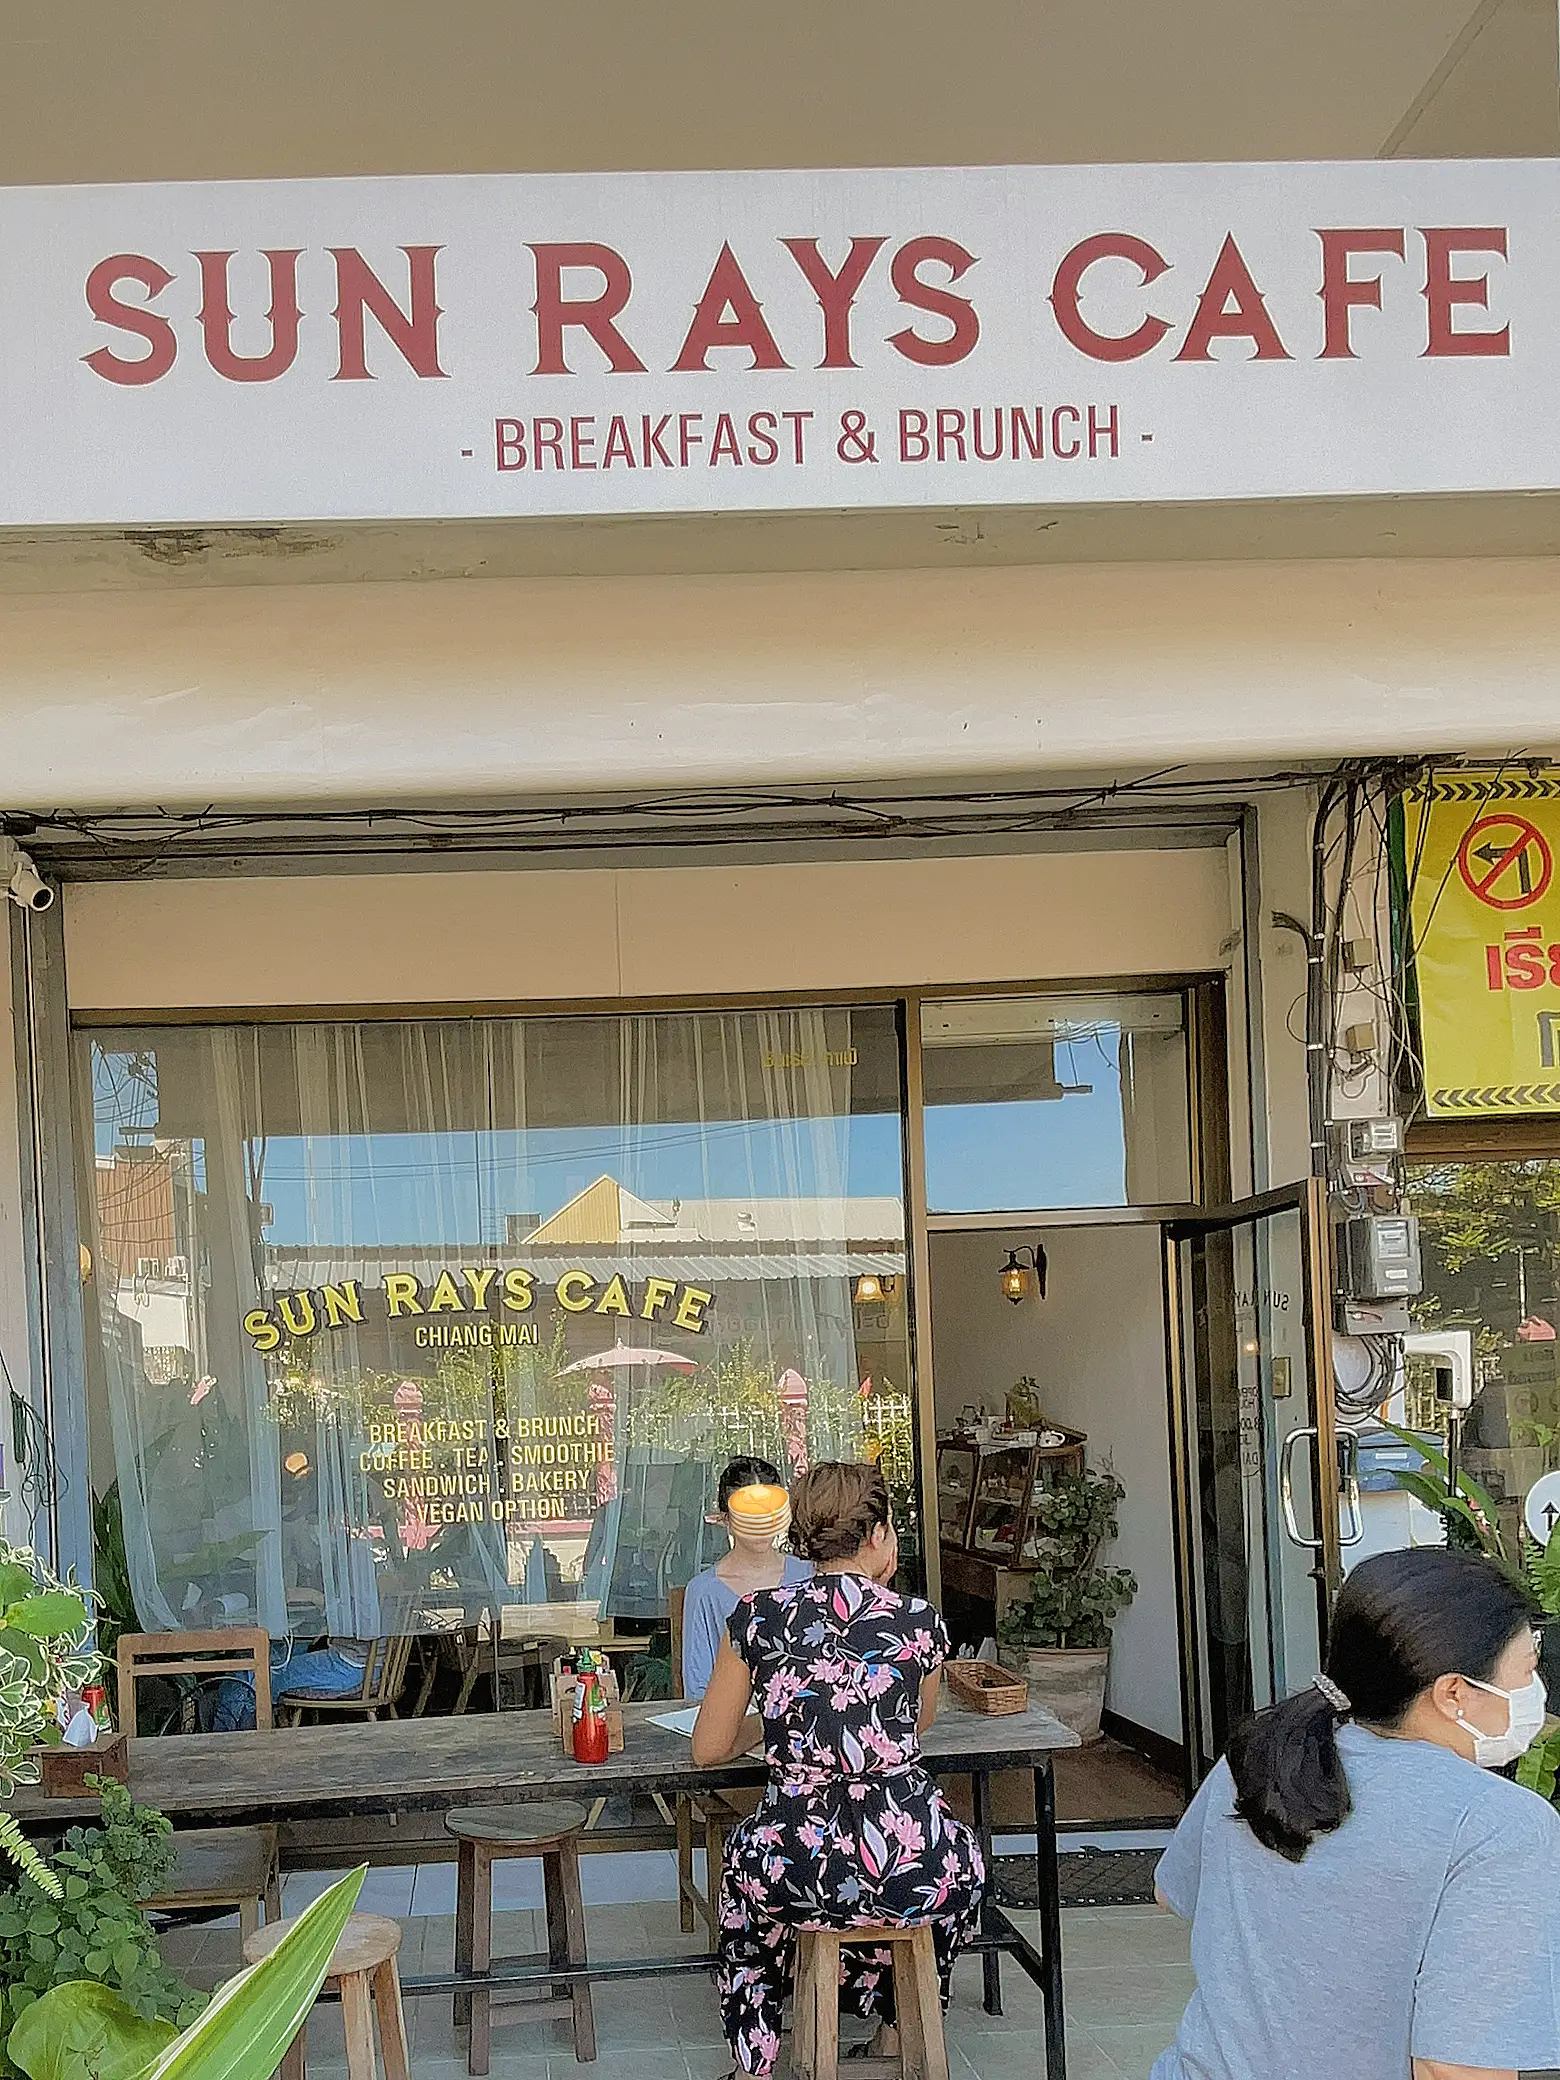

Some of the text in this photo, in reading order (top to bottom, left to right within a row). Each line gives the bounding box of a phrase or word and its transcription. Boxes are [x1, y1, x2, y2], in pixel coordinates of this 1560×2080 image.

[79, 226, 1512, 387] SUN RAYS CAFE
[495, 411, 814, 472] BREAKFAST
[836, 409, 880, 464] &
[898, 404, 1121, 463] BRUNCH
[1485, 925, 1560, 991] เรี
[243, 1279, 366, 1351] SUN
[383, 1267, 537, 1318] RAYS
[555, 1268, 715, 1333] CAFE
[414, 1323, 539, 1348] CHIANG MAI
[370, 1415, 600, 1443] BREAKFAST & BRUNCH
[360, 1449, 433, 1472] COFFEE
[453, 1447, 489, 1469] TEA
[511, 1441, 615, 1466] SMOOTHIE
[383, 1473, 491, 1499] SANDWICH
[512, 1469, 590, 1493] BAKERY
[417, 1497, 565, 1525] VEGAN OPTION
